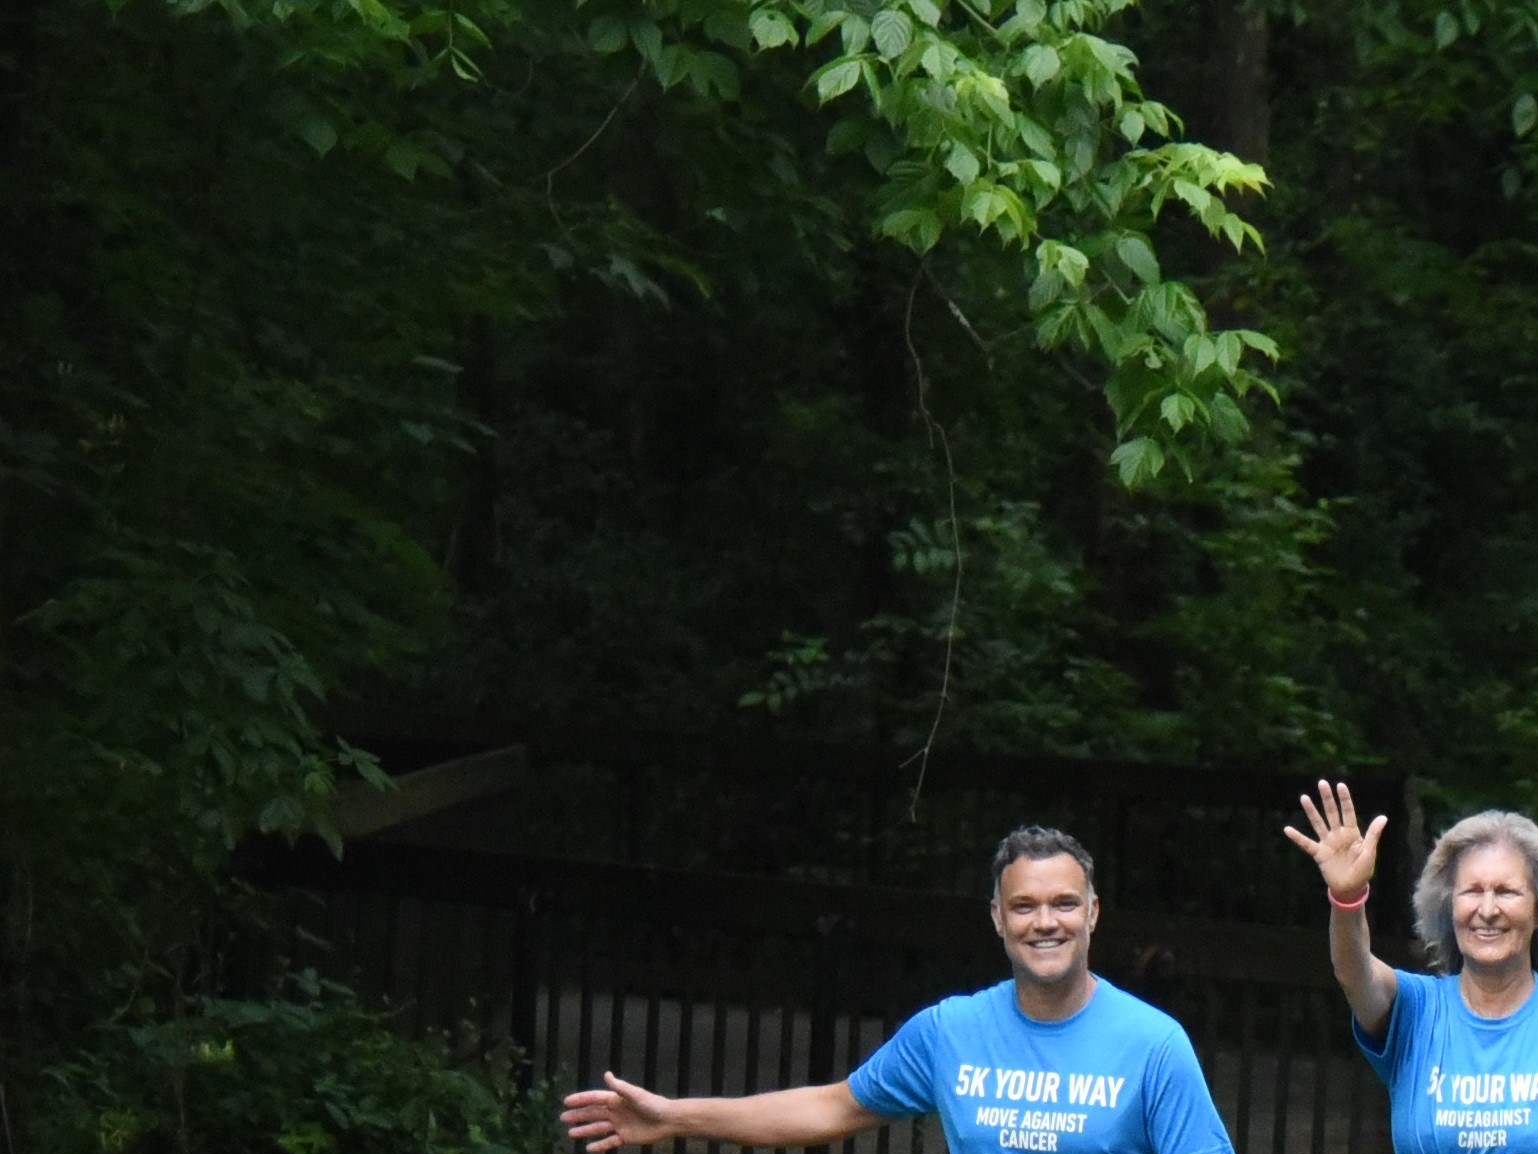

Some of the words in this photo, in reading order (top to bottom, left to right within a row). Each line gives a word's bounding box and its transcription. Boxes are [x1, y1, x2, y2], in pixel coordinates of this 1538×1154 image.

[955, 1065, 990, 1098] 5K
[995, 1068, 1061, 1103] YOUR
[1068, 1073, 1125, 1108] WAY
[1451, 1073, 1505, 1105] YOUR
[976, 1106, 1019, 1128] MOVE
[1021, 1110, 1087, 1133] AGAINST
[999, 1129, 1058, 1152] CANCER
[1458, 1129, 1507, 1149] CANCER
